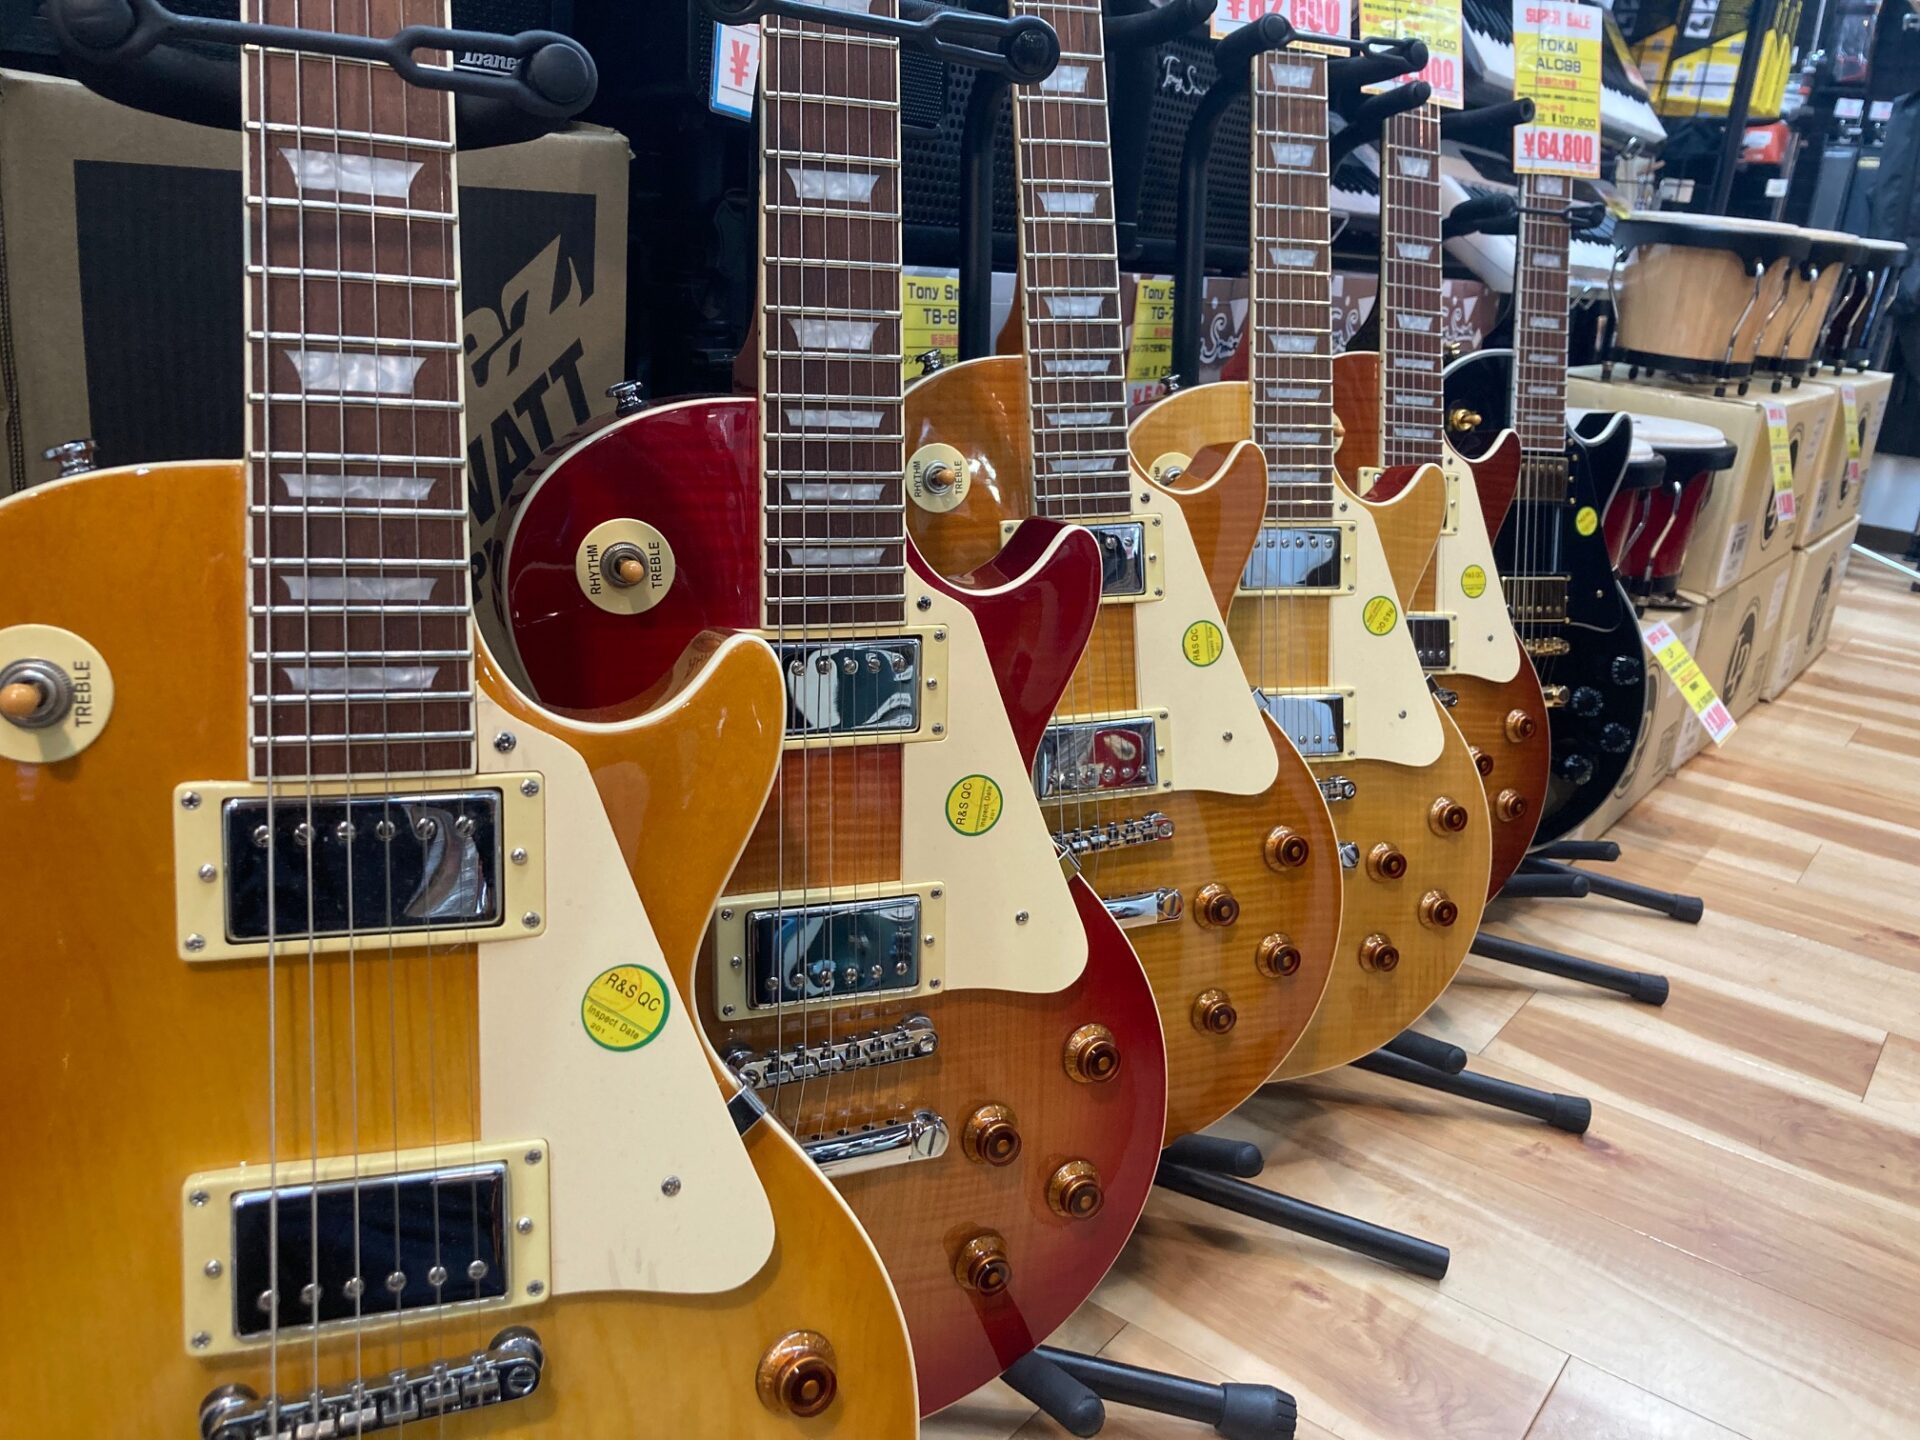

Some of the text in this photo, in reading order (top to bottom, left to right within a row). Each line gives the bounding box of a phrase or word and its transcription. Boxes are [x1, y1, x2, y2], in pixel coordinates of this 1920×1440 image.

[1540, 38, 1578, 54] TOKAI
[1524, 131, 1593, 164] ¥64,800
[907, 282, 939, 300] Tony
[913, 460, 921, 498] RHYTHM
[954, 460, 963, 495] TREBLE
[586, 544, 602, 595] RHYTHM
[648, 541, 662, 589] TREBLE
[73, 660, 93, 728] TREBLE
[956, 782, 972, 826] R&S QC
[605, 972, 661, 1012] R&S QC
[587, 1005, 640, 1040] Inspect Date
